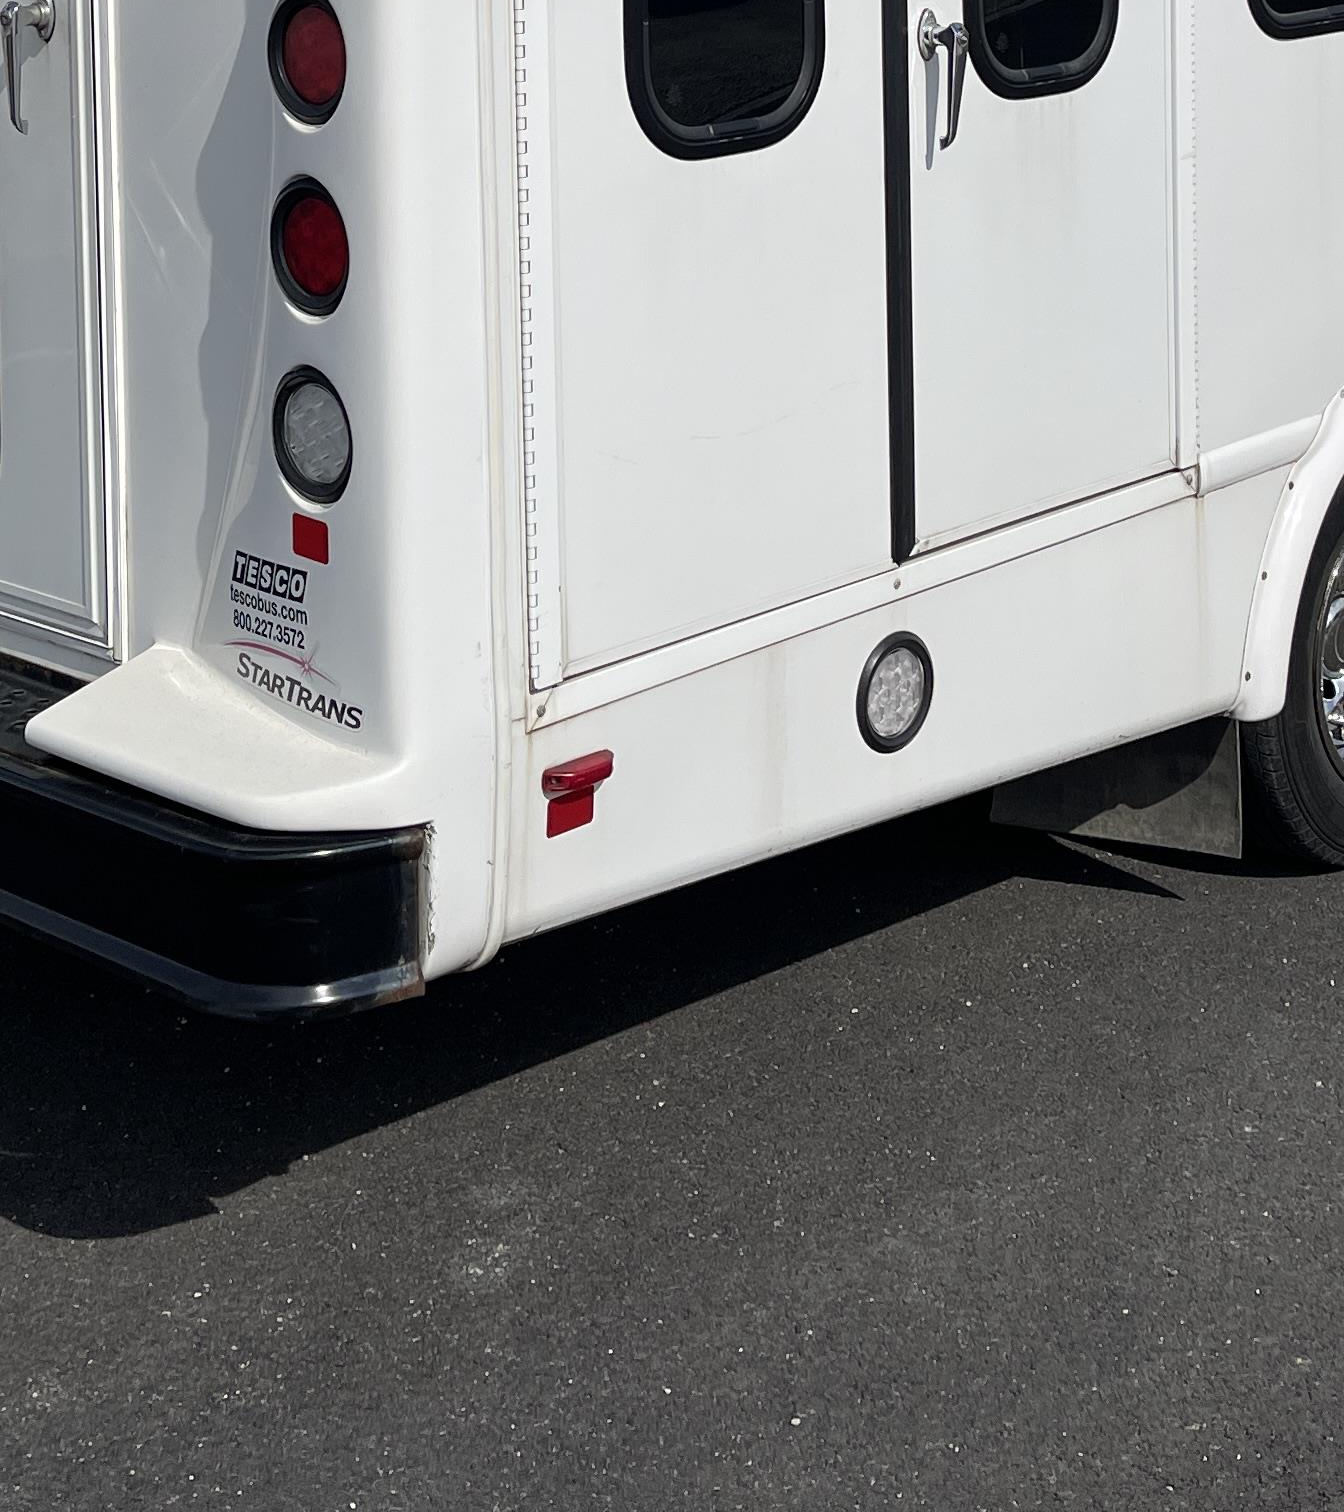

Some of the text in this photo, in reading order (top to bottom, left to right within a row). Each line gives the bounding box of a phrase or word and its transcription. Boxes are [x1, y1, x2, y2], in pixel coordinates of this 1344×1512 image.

[232, 550, 308, 603] TESCO
[230, 584, 308, 625] tescobus.com
[233, 609, 305, 649] 800.227.3572
[236, 652, 363, 730] STARTRANS
